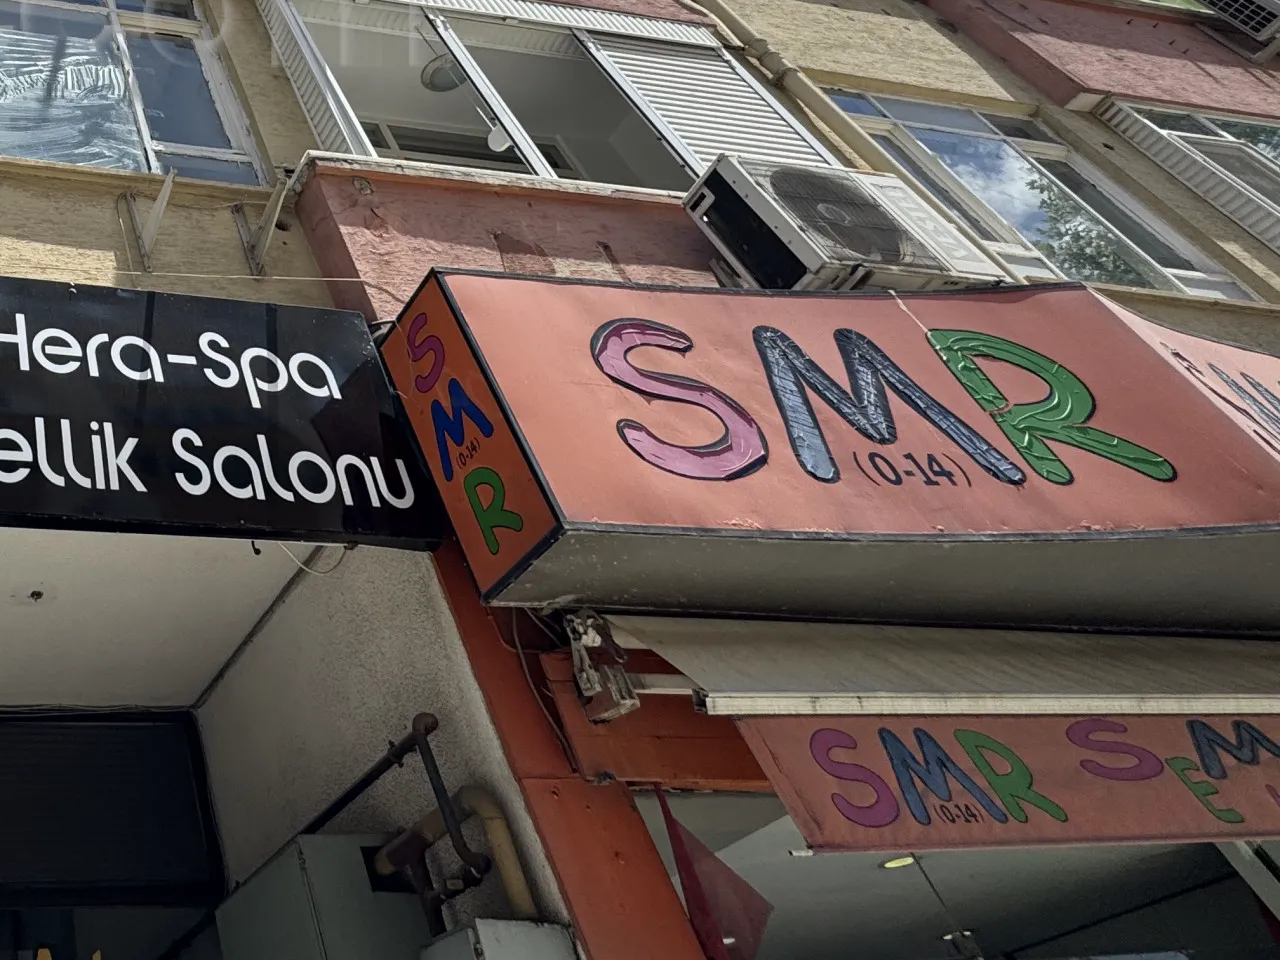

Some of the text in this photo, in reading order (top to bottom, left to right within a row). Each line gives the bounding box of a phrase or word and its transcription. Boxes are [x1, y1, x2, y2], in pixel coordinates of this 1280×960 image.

[407, 312, 524, 555] SMR
[589, 318, 1177, 484] SMR
[172, 428, 415, 509] Salonu
[852, 451, 972, 488] (0-14)
[810, 727, 1069, 829] SMR
[933, 801, 985, 824] (0-14)
